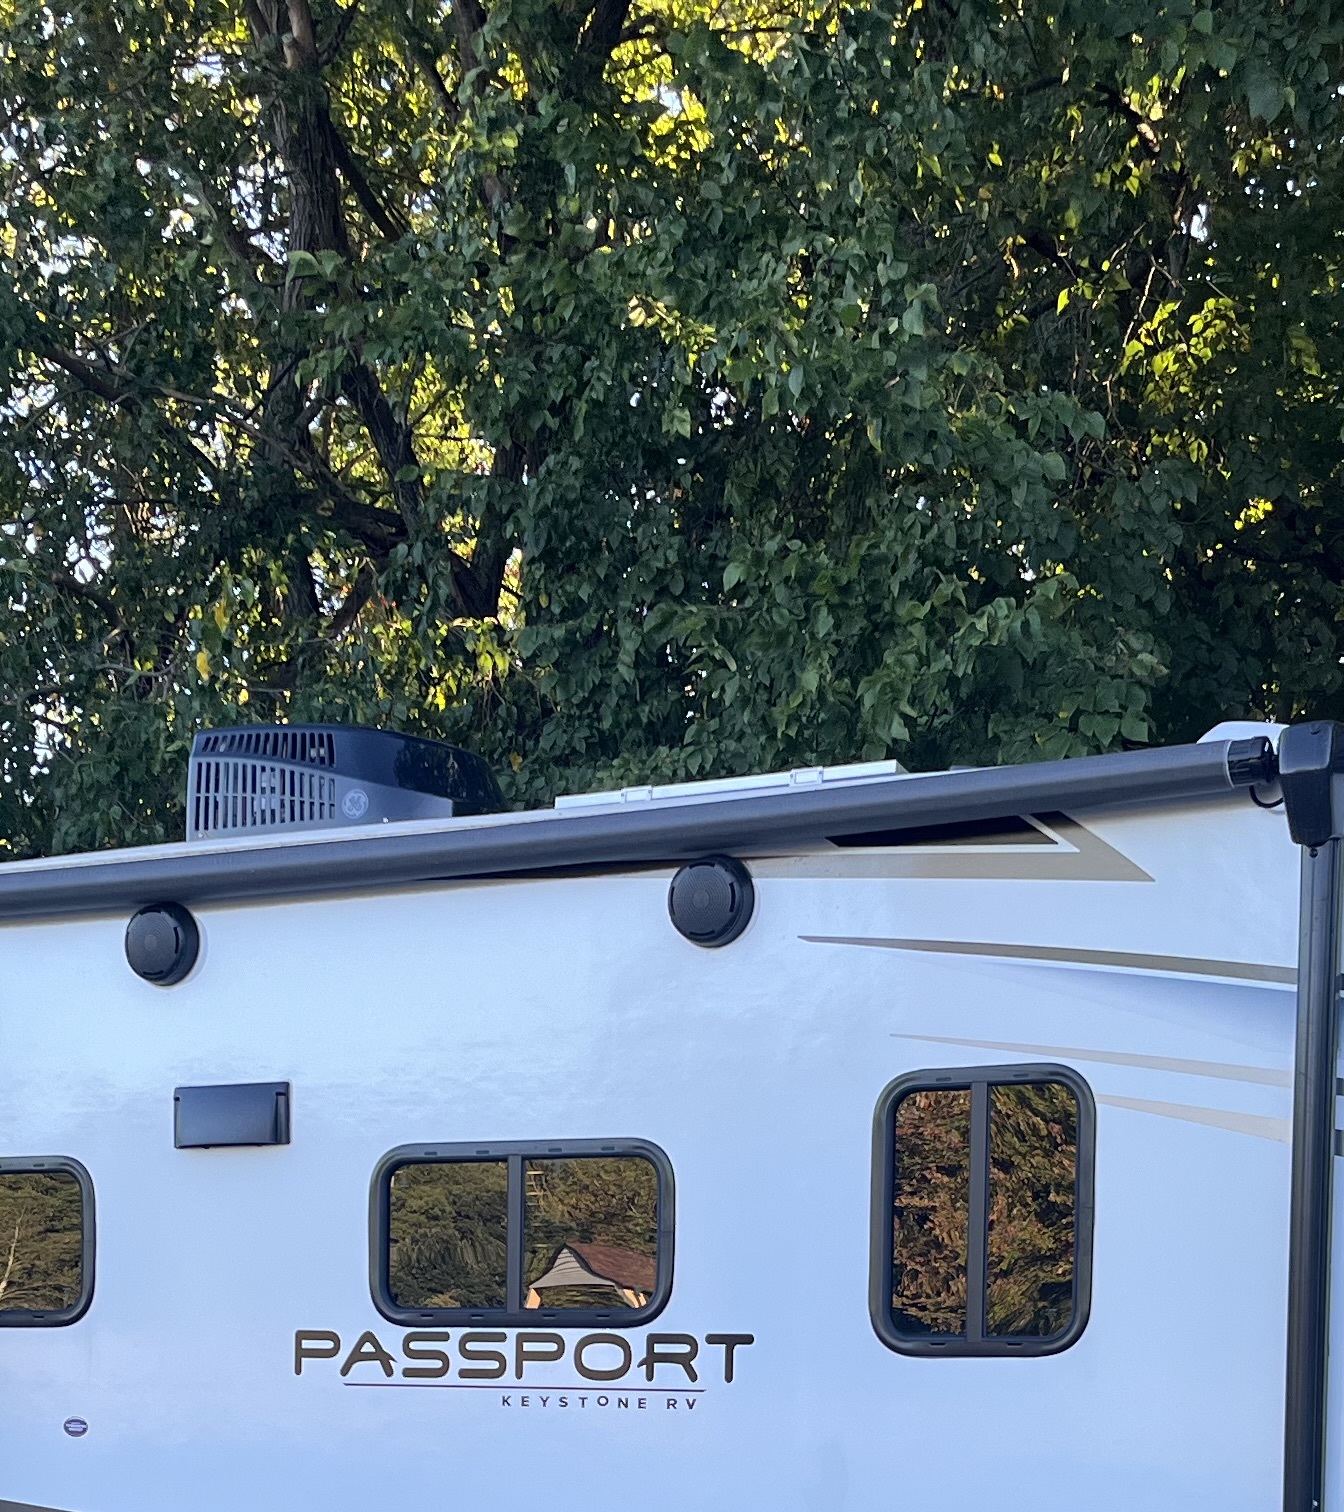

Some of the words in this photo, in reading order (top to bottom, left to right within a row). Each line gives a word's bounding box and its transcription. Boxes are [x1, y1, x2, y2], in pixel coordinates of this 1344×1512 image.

[294, 1330, 755, 1383] PASSPORT
[501, 1395, 648, 1410] KEYSTONE
[666, 1398, 698, 1411] RV
